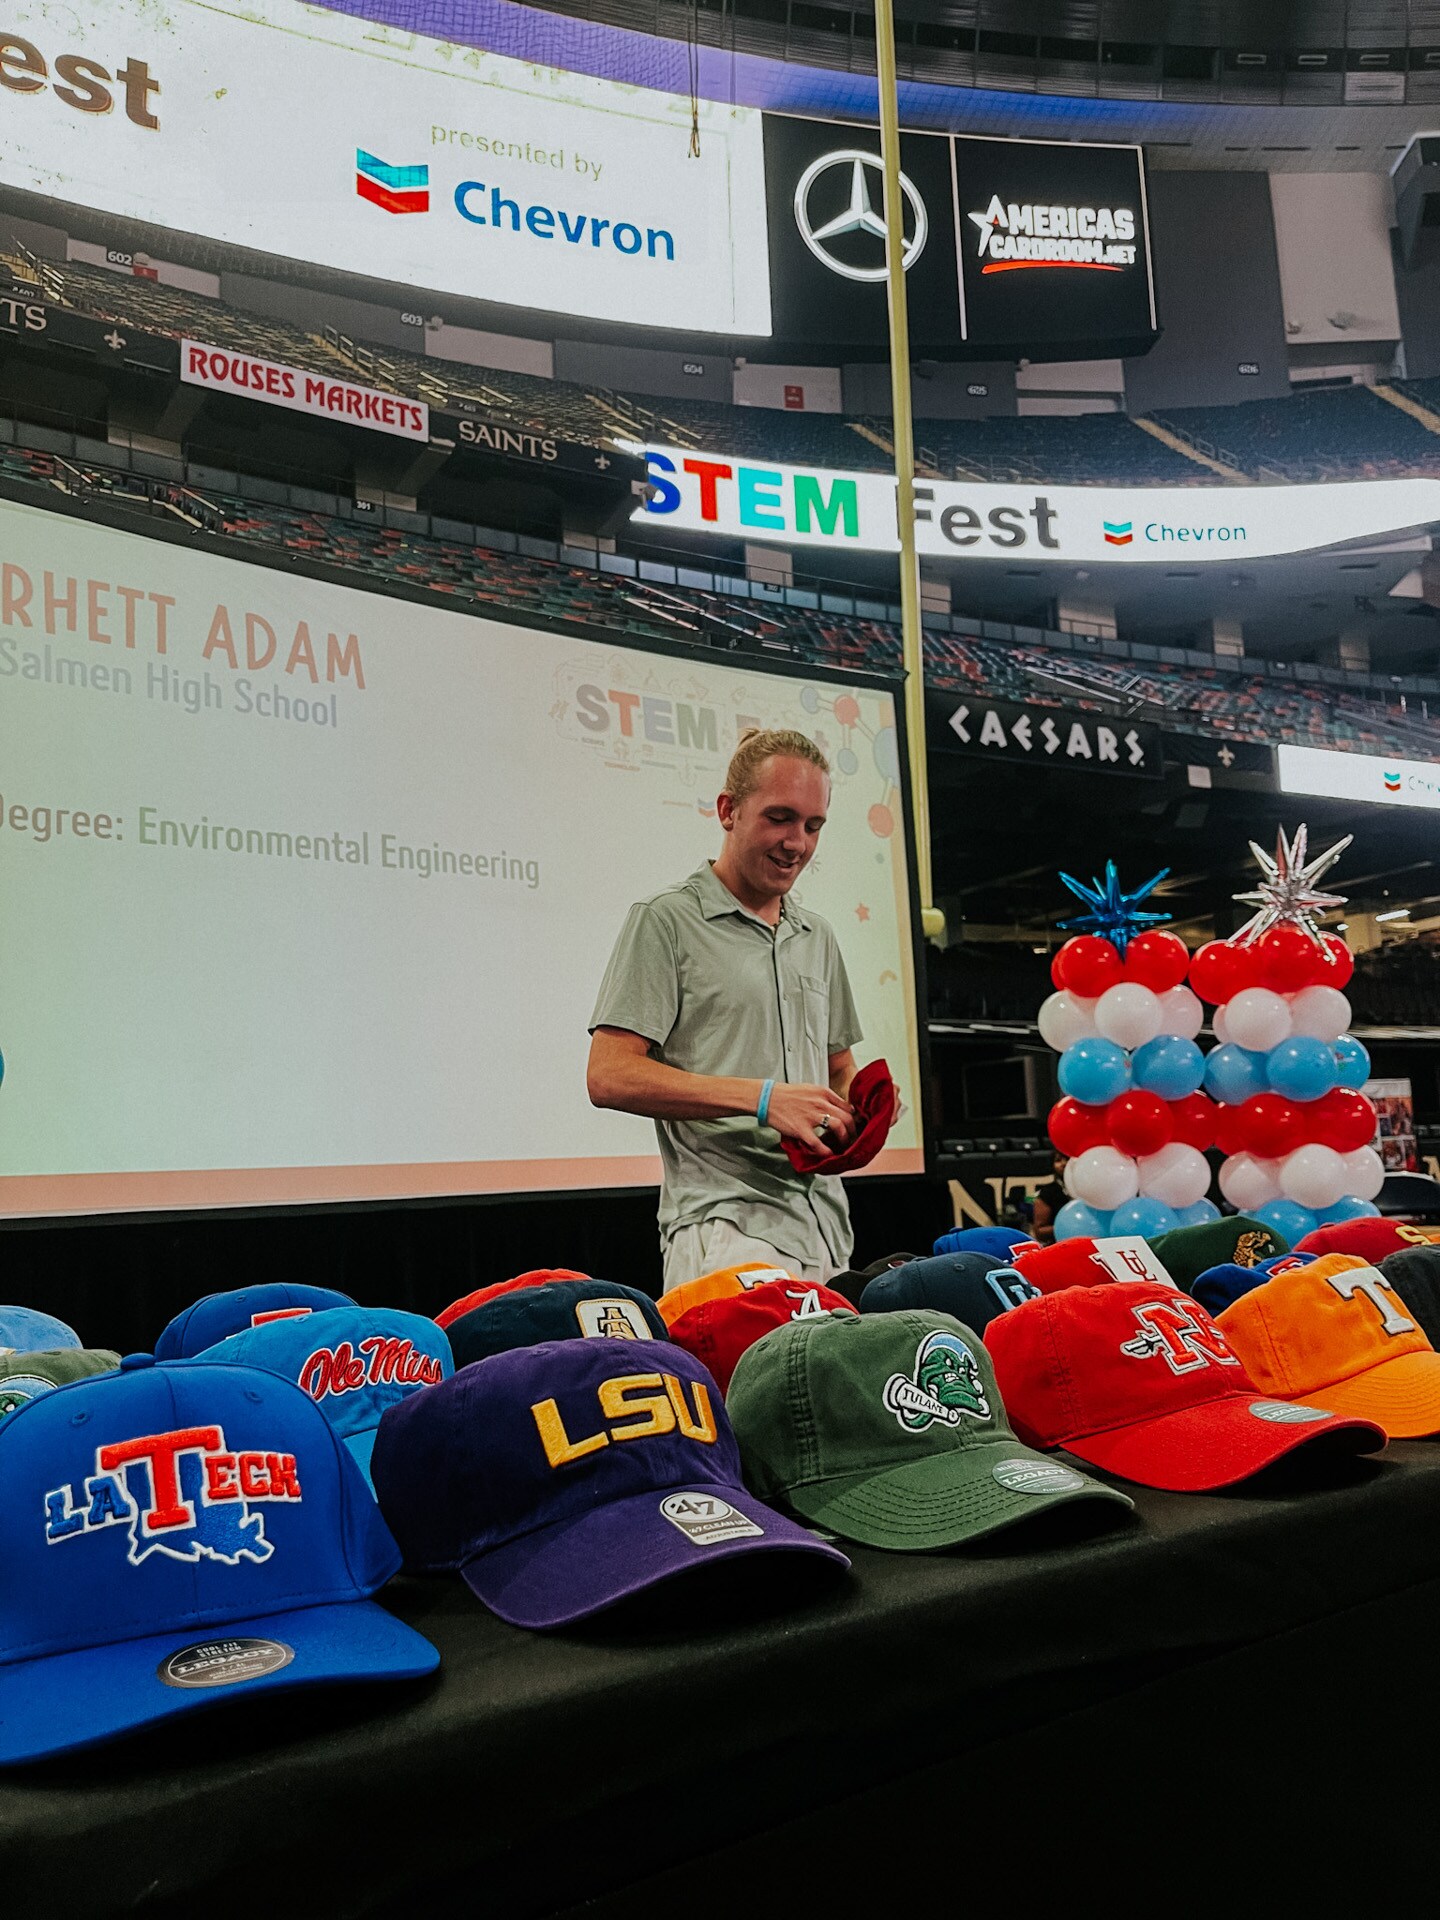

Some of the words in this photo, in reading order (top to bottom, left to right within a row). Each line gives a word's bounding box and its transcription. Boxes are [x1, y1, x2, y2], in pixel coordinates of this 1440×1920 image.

[431, 125, 564, 170] presented
[575, 152, 602, 181] by
[454, 181, 674, 260] Chevron
[107, 251, 132, 265] 602
[401, 313, 423, 326] 603
[188, 347, 295, 399] ROUSES
[305, 378, 423, 432] MARKETS
[458, 420, 558, 461] SAINTS
[644, 450, 859, 538] STEM
[1145, 522, 1247, 544] Chevron
[1, 562, 176, 655] RHETT
[202, 604, 366, 690] ADAM
[0, 636, 132, 695] Salmen
[147, 661, 222, 715] High
[234, 677, 338, 728] School
[576, 683, 719, 752] STEM
[0, 795, 124, 843] egree:
[139, 806, 370, 865] Environmental
[381, 834, 541, 889] Engineering
[1325, 1266, 1416, 1337] T
[299, 1342, 366, 1403] Ole
[359, 1336, 444, 1386] Miss
[902, 1387, 943, 1414] TULANE
[531, 1373, 717, 1469] LSU
[178, 1648, 274, 1674] LEGACY
